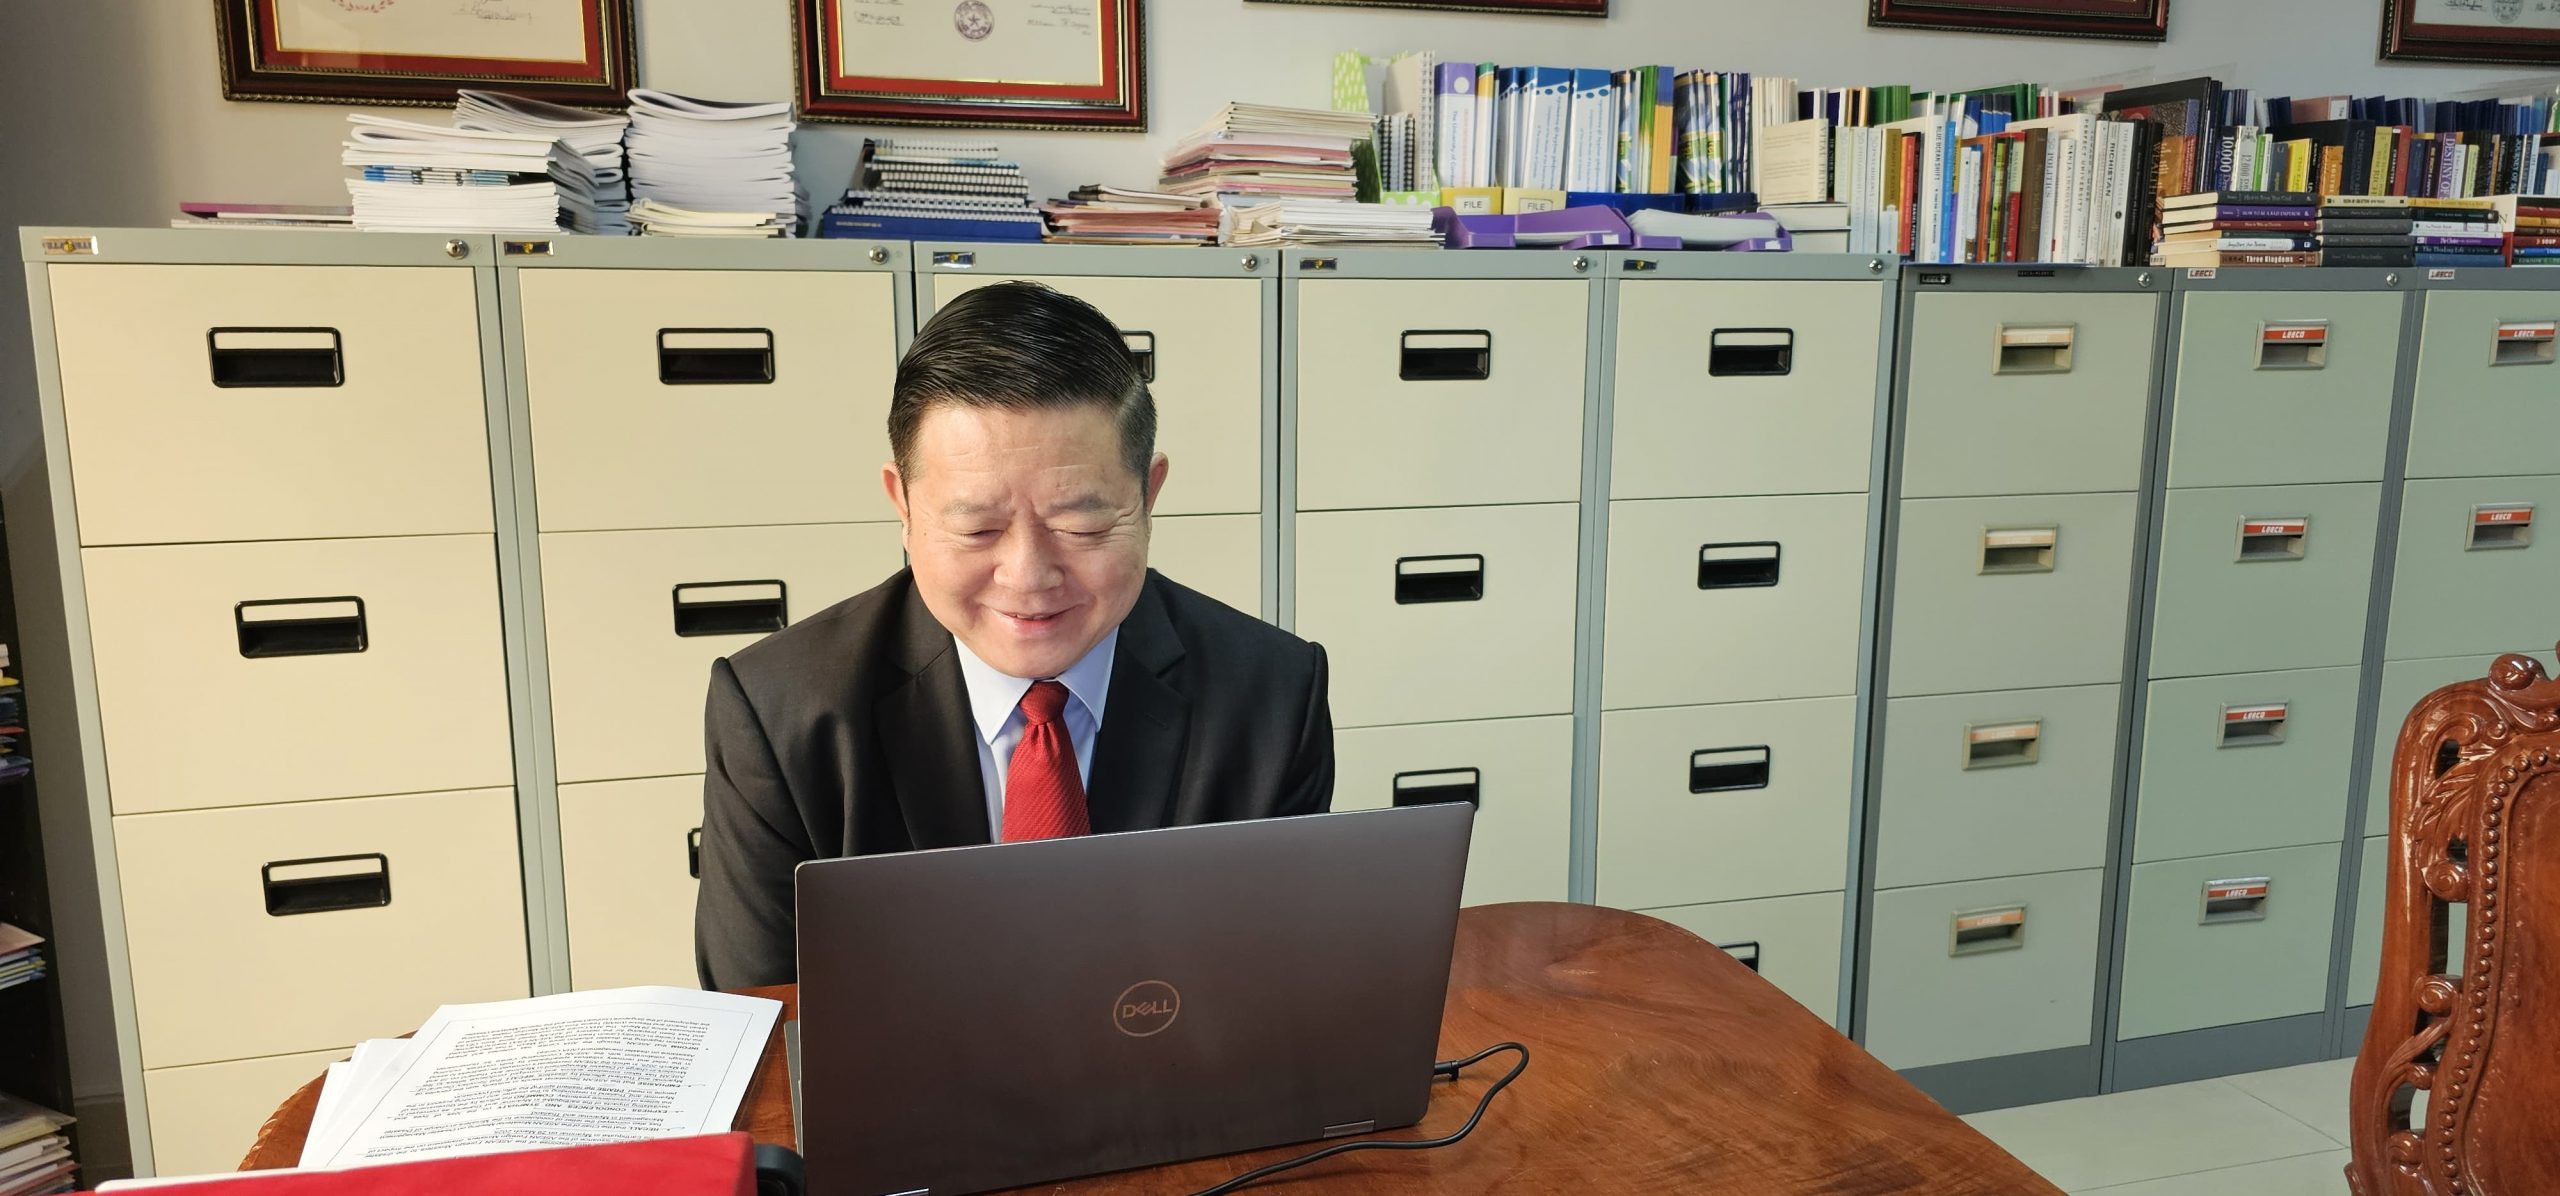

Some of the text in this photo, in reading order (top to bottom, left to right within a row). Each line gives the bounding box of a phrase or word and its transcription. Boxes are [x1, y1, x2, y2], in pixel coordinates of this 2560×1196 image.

[1818, 127, 1826, 156] VITAL
[2513, 138, 2522, 171] JOURNEY
[2077, 119, 2089, 213] PERFECT UNIVERSITY
[2105, 142, 2115, 197] RICHISTAN
[2148, 142, 2160, 195] WEALTH
[2440, 138, 2455, 194] DESTINY OF
[2045, 152, 2054, 198] POLITICS
[2512, 172, 2518, 181] OF
[1527, 202, 1545, 210] FILE
[2246, 255, 2294, 264] Three Kingdoms
[2190, 270, 2214, 278] LEECO
[2282, 330, 2304, 338] LEECO
[2513, 330, 2534, 338] LEECO
[2491, 512, 2512, 521] LEECO
[2262, 526, 2284, 534] LEECO
[2244, 711, 2264, 720] LEECO
[2226, 890, 2247, 898] LEECO
[1122, 1000, 1173, 1018] DELL
